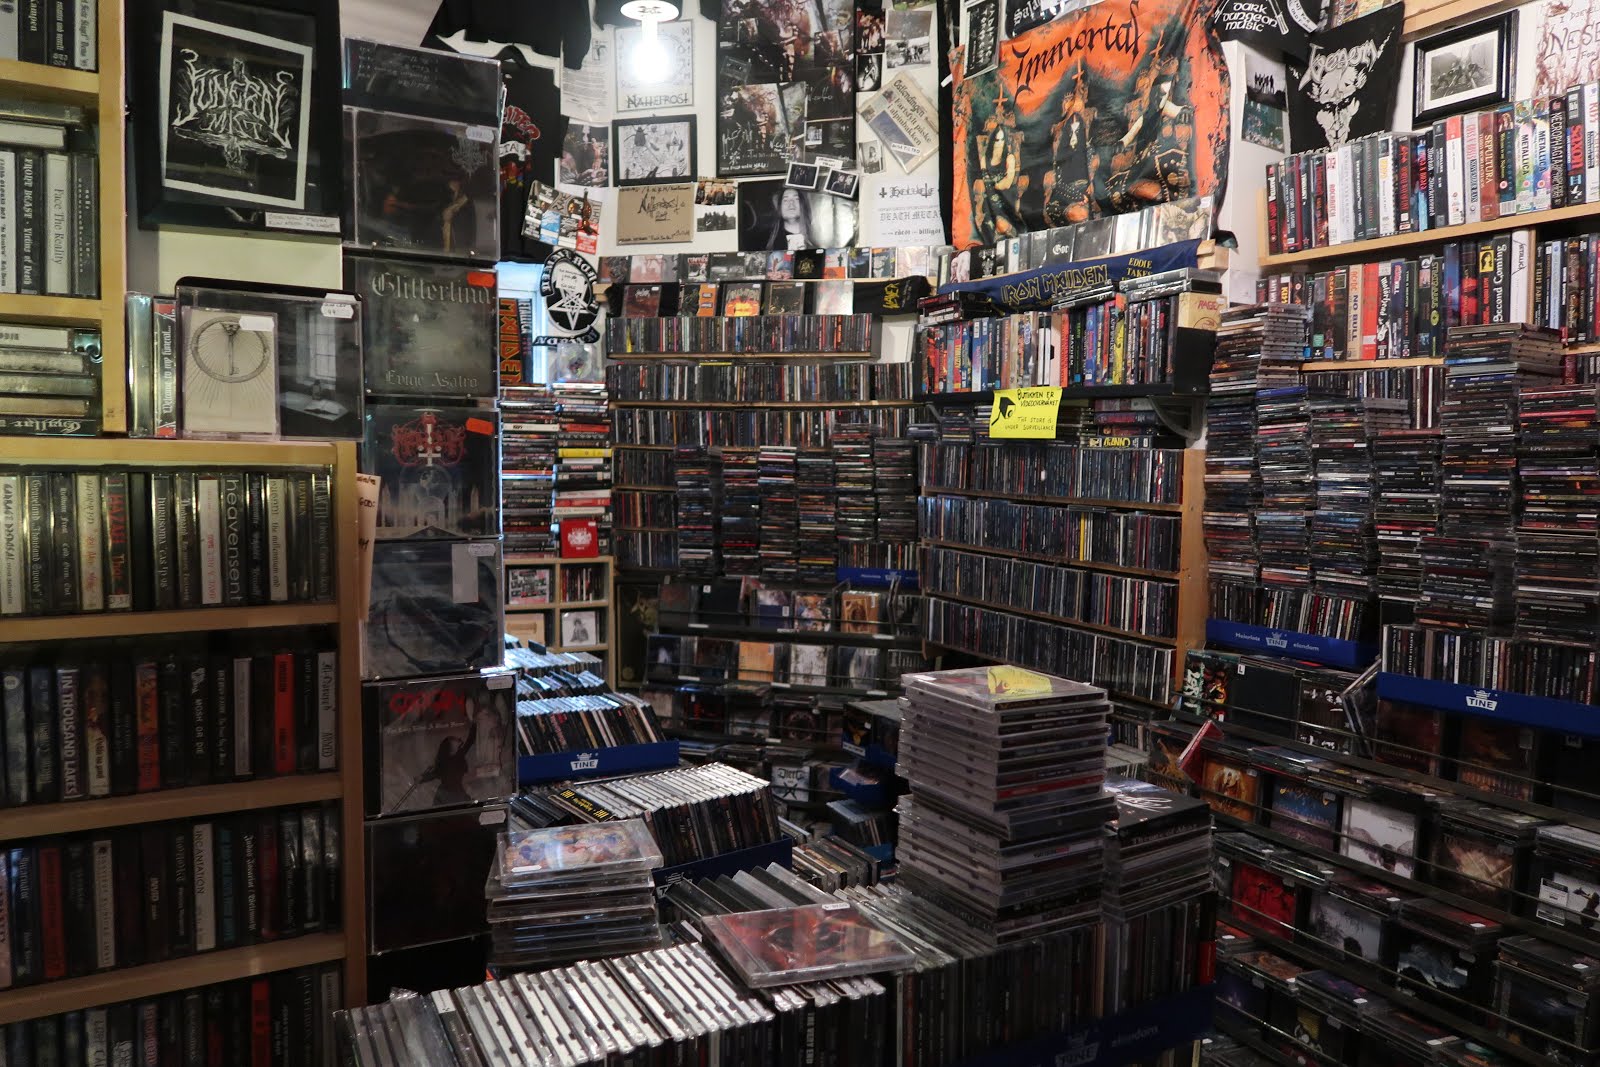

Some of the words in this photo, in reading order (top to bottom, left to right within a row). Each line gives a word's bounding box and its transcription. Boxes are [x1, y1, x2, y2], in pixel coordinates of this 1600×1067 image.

[1012, 1, 1144, 95] Immortal
[172, 49, 293, 149] FUNERAL
[1521, 134, 1530, 176] METALLICA
[1538, 131, 1547, 172] METALLICA
[1551, 112, 1563, 165] NECROPHAGIA
[1571, 124, 1584, 170] saxon
[1484, 134, 1494, 184] SEPULTURA
[54, 188, 65, 210] Face
[54, 213, 65, 231] The
[51, 233, 65, 265] Reality
[1127, 257, 1152, 270] EDDIE
[1493, 244, 1508, 284] Coming
[1001, 277, 1041, 306] IRON
[1041, 264, 1107, 295] MAIDEN
[1352, 295, 1359, 310] NO
[1493, 287, 1504, 323] Second
[30, 480, 42, 520] Graveland
[226, 479, 243, 601] heavensent
[1269, 638, 1287, 648] TINE
[61, 675, 73, 688] IN
[1469, 697, 1494, 709] TINE
[62, 692, 75, 757] THOUSAND
[64, 761, 78, 793] LAKES
[573, 760, 596, 769] TINE
[193, 830, 205, 894] INCANTATION
